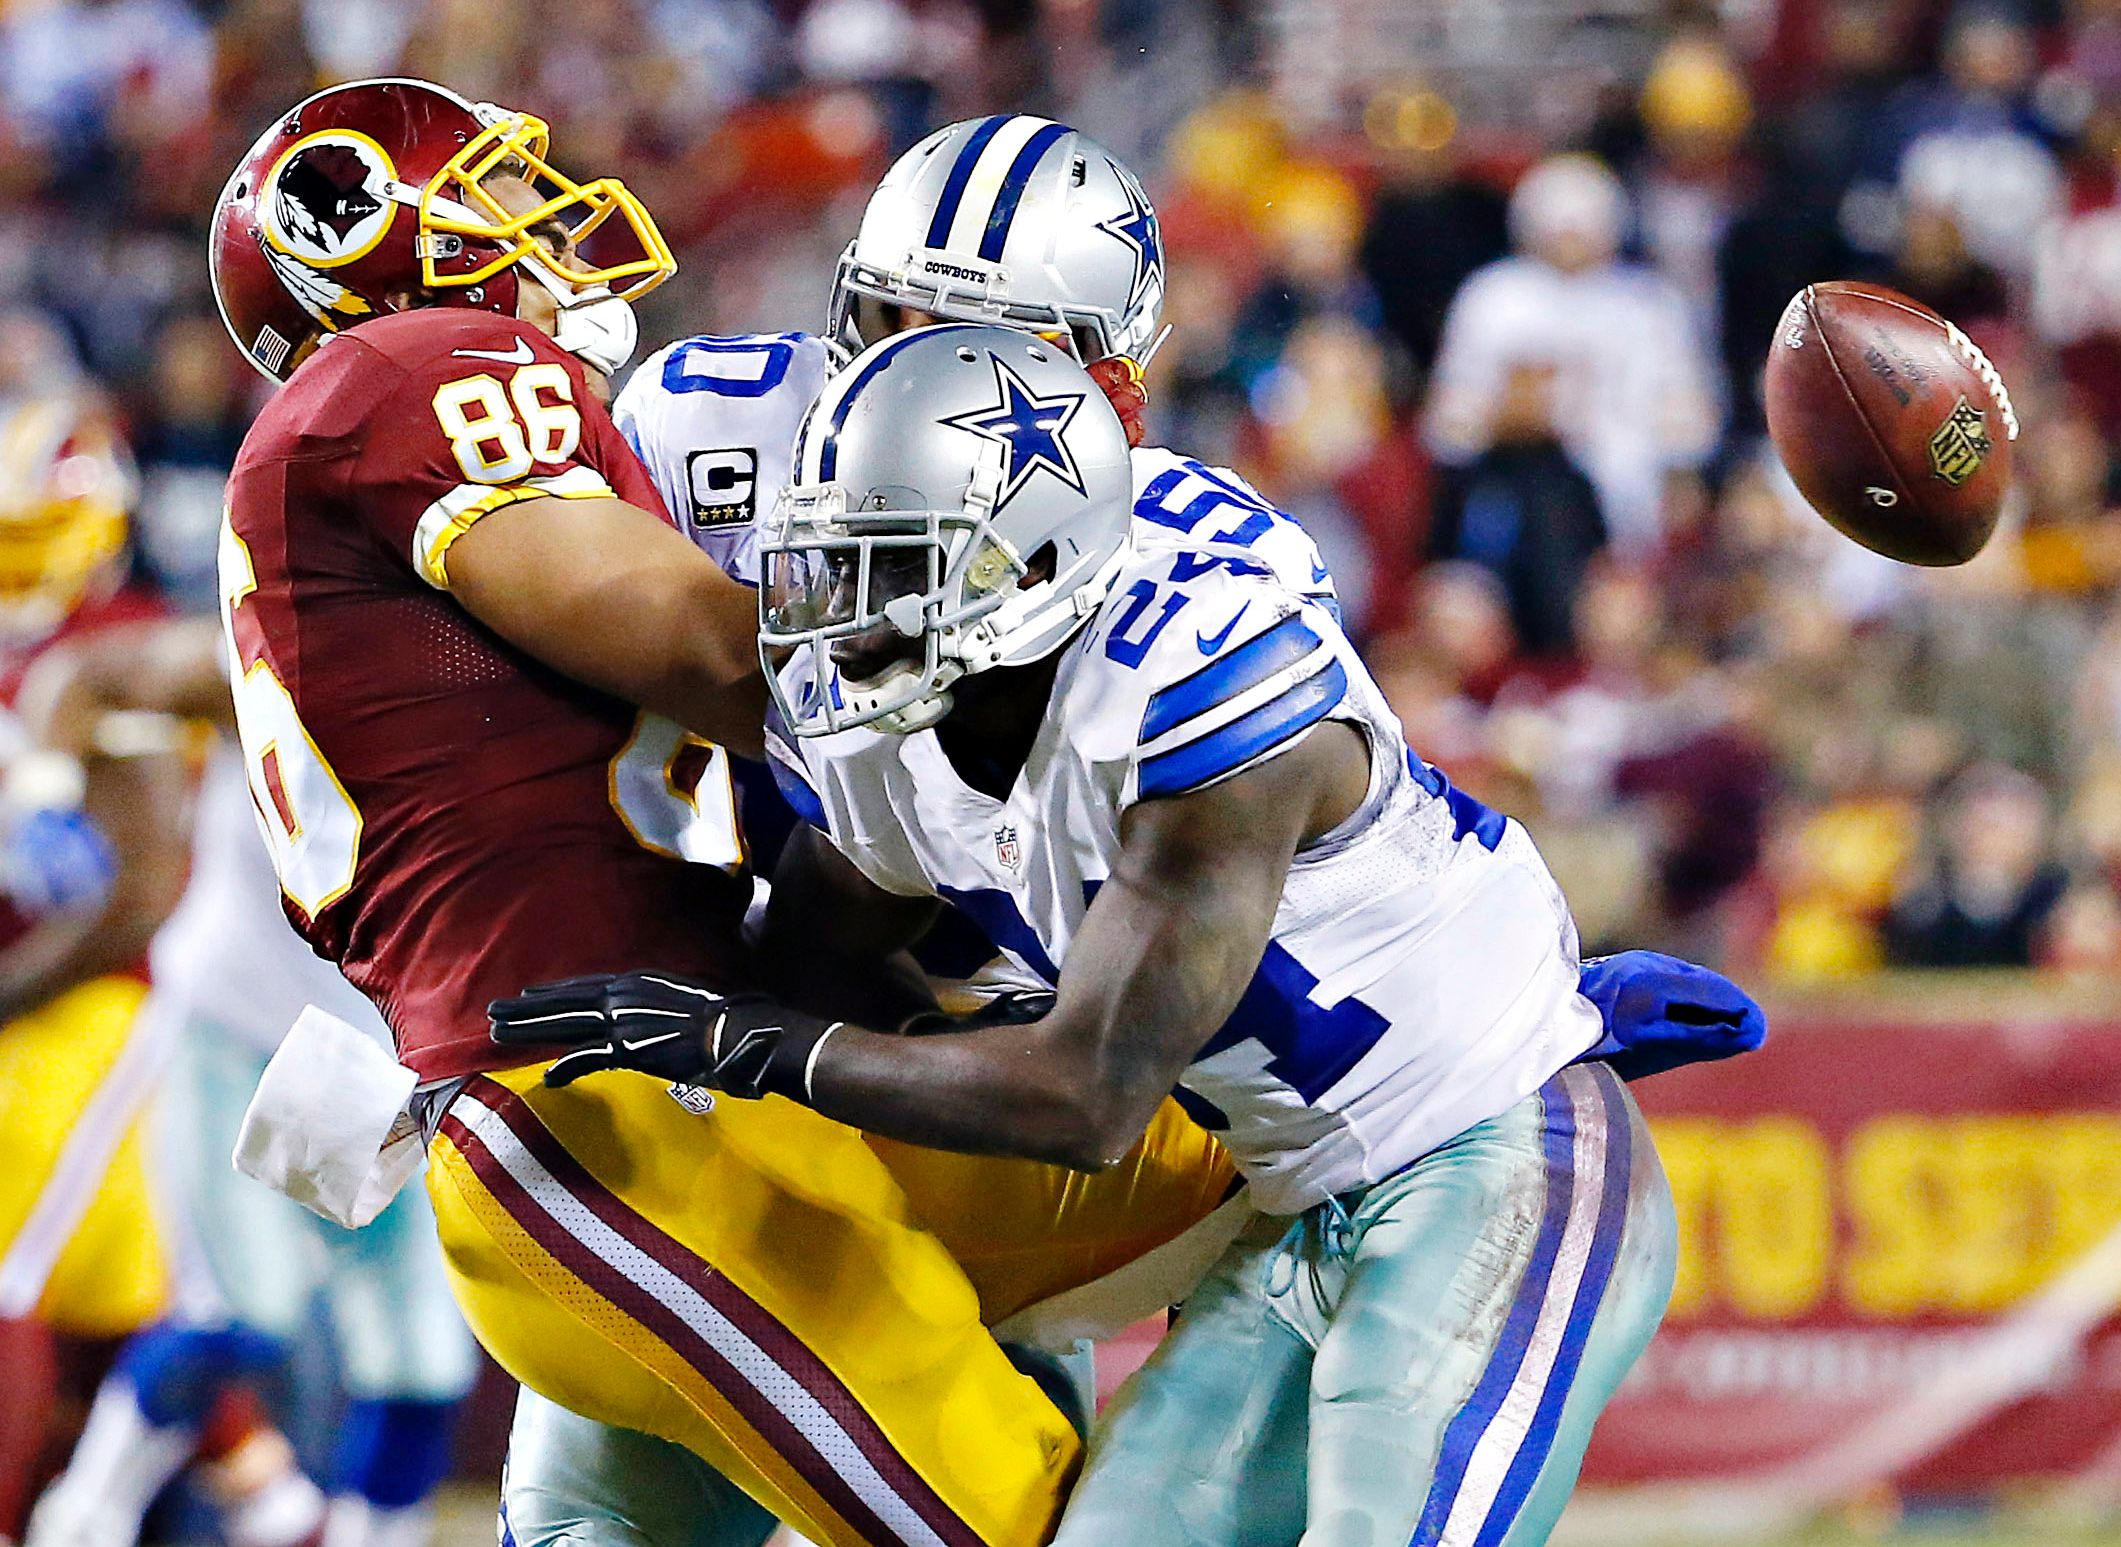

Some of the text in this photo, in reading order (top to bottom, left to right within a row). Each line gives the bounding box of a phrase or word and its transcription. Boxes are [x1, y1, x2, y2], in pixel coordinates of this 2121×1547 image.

[925, 261, 987, 284] COWBOYS
[431, 363, 581, 484] 86
[1933, 421, 1981, 479] NFL
[691, 451, 754, 506] C
